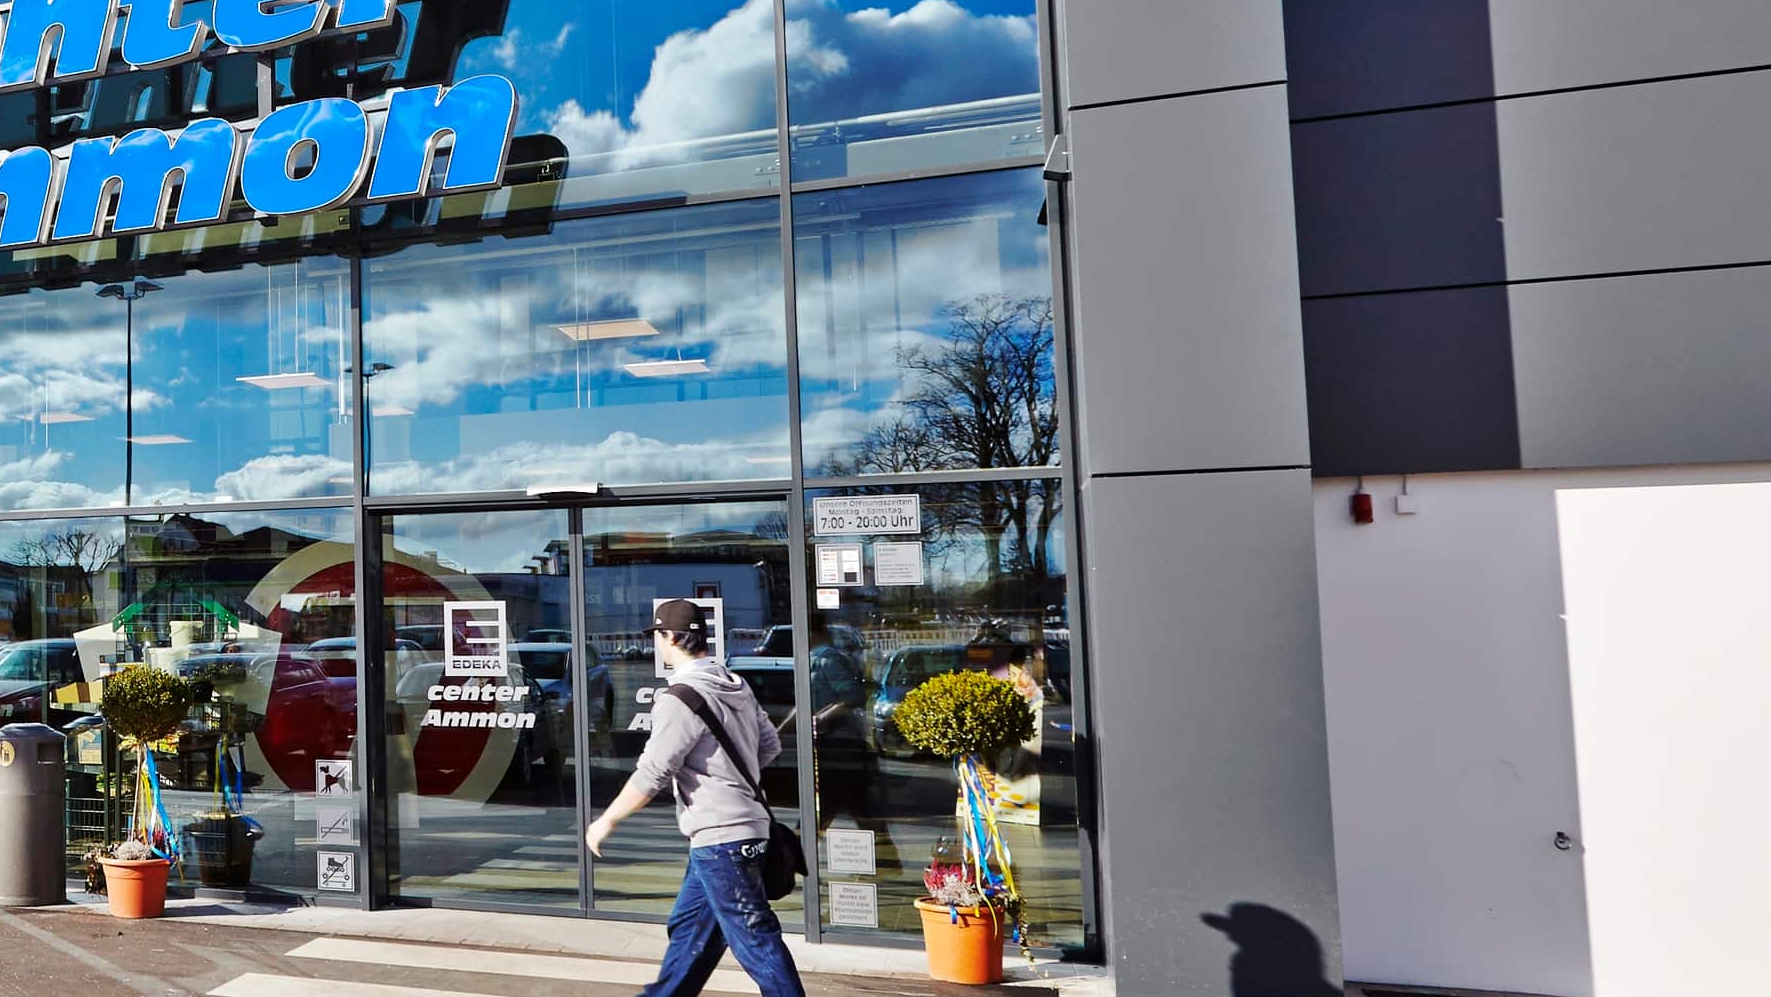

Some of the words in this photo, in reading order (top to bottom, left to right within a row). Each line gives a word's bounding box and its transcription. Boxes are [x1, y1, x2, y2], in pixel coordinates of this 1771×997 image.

[821, 517, 844, 529] 7:00
[856, 516, 887, 528] 20:00
[891, 515, 914, 527] Uhr
[452, 659, 502, 669] EDEKA
[427, 683, 530, 702] center
[420, 708, 536, 728] Ammon
